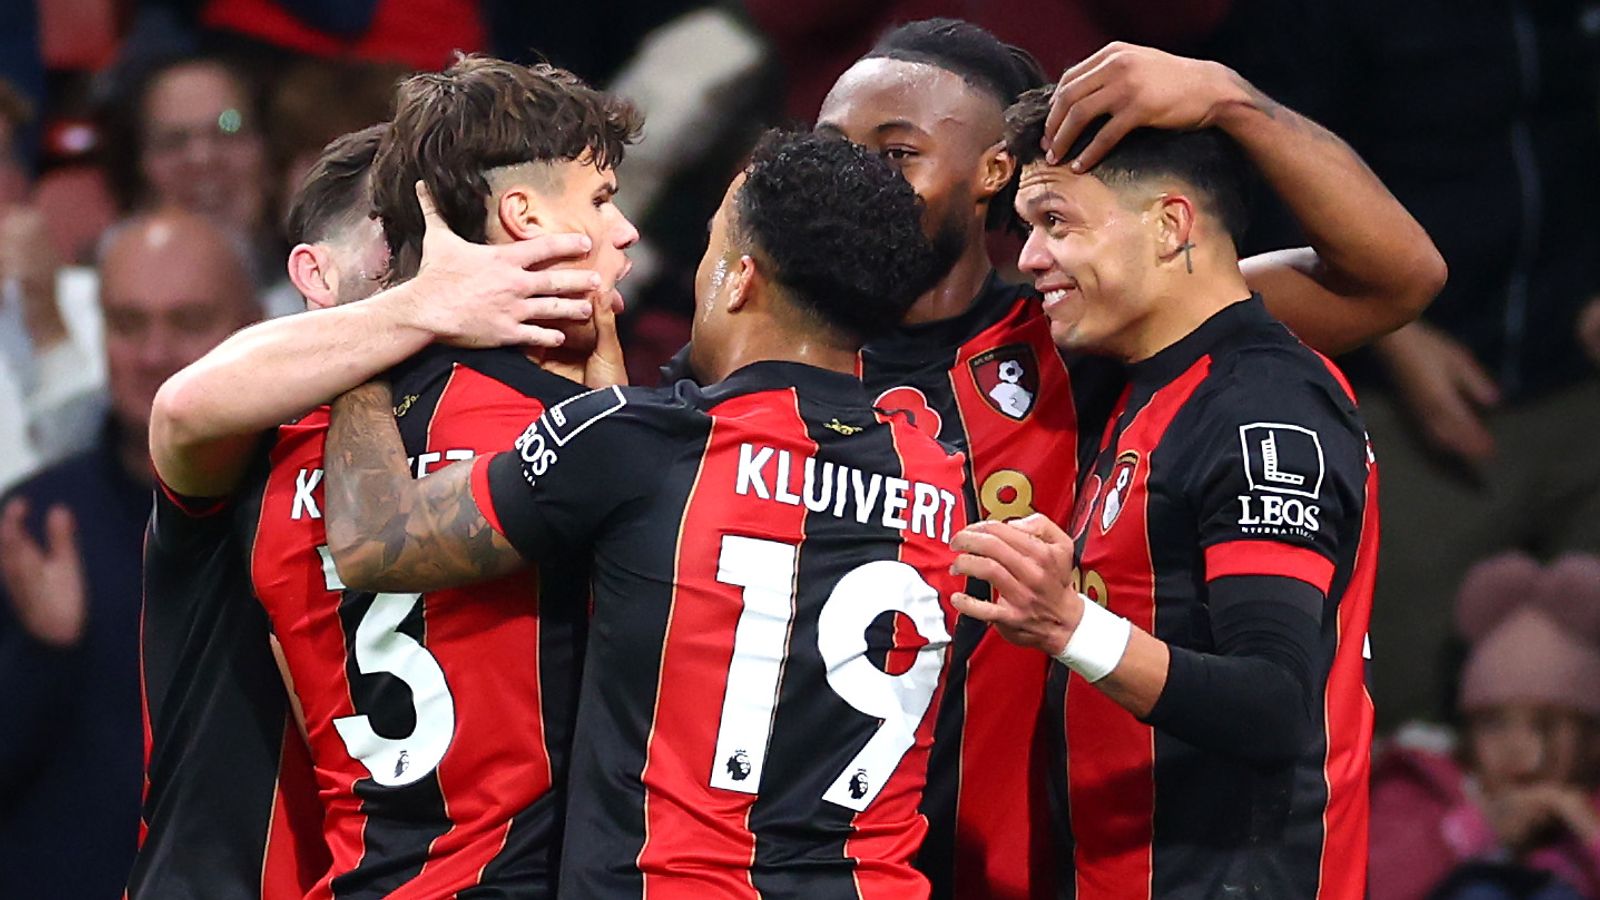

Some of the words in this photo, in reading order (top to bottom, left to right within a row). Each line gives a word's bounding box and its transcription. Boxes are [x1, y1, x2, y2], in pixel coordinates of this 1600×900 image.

[735, 443, 956, 544] KLUIVERT
[1237, 495, 1320, 532] LEOS
[709, 534, 952, 813] 19
